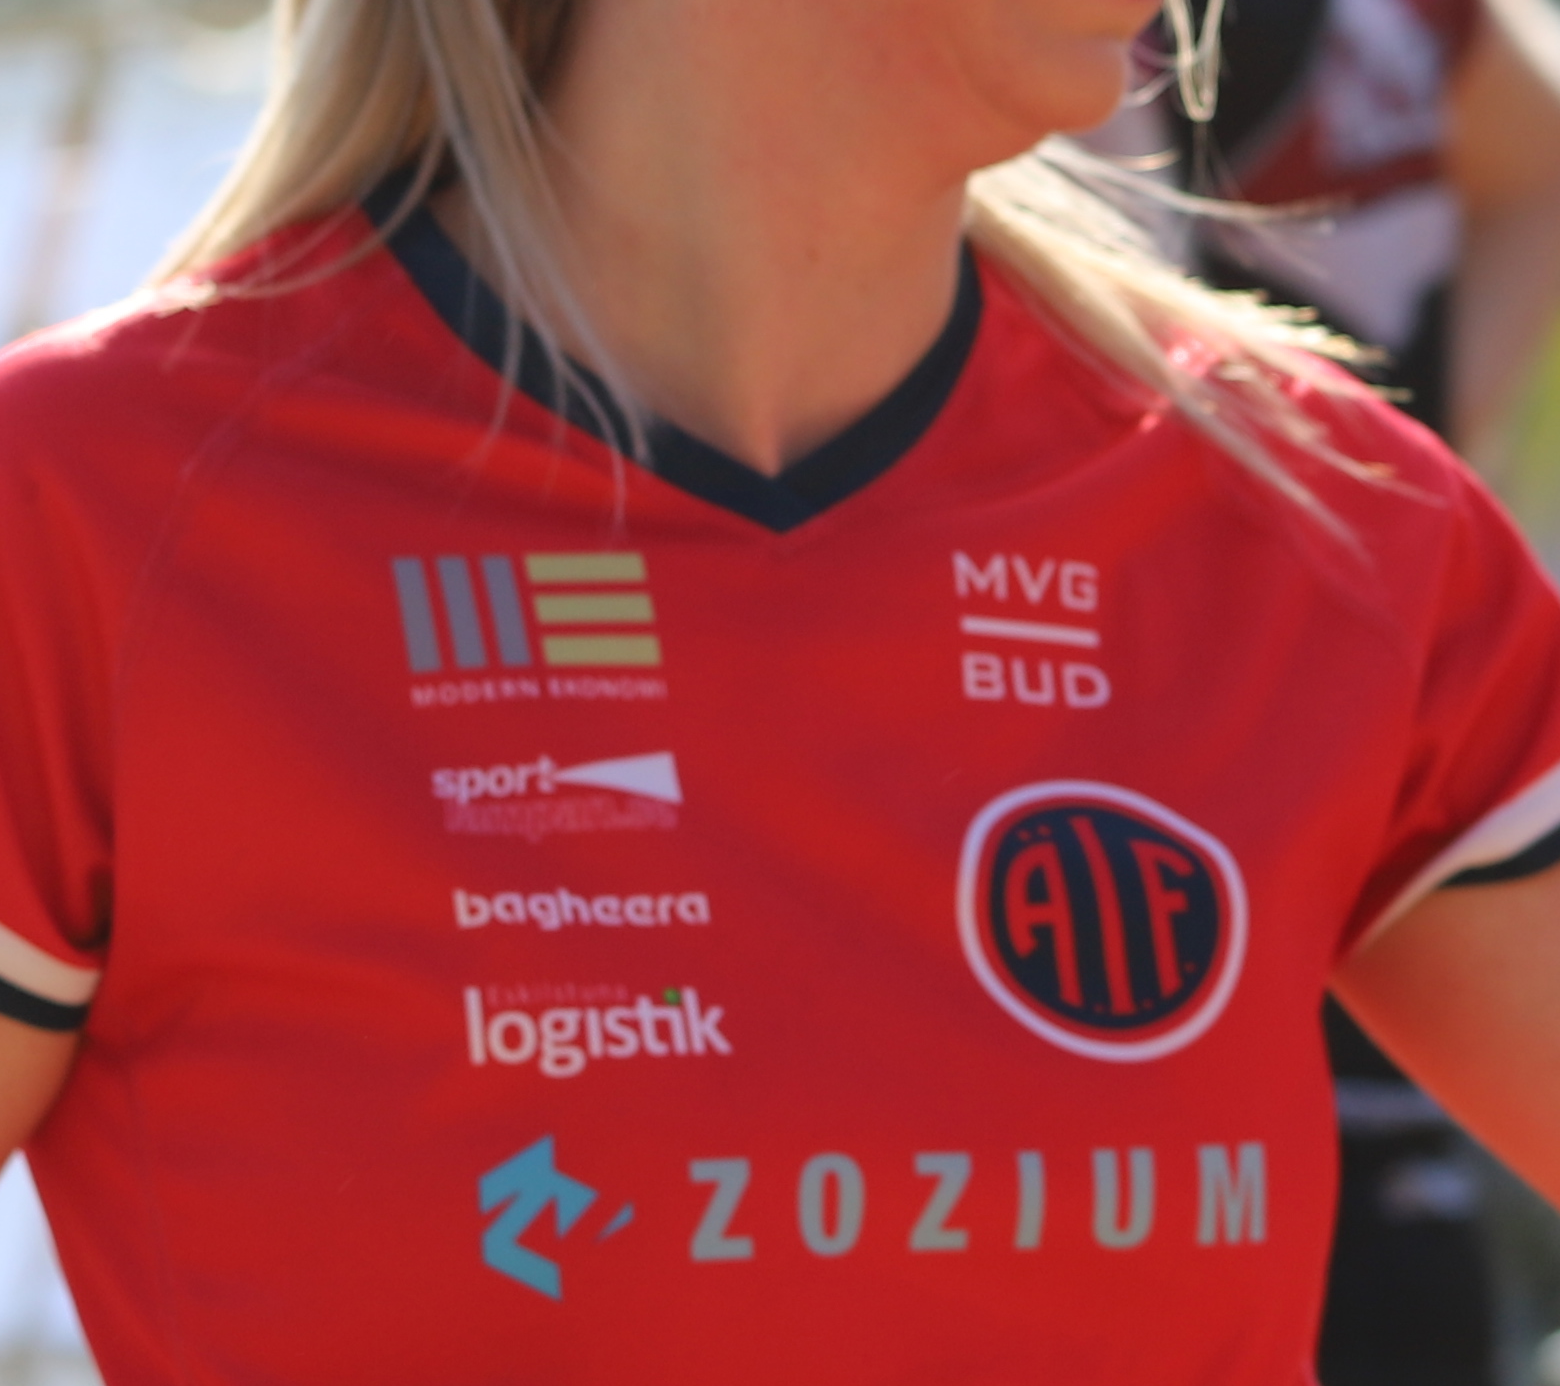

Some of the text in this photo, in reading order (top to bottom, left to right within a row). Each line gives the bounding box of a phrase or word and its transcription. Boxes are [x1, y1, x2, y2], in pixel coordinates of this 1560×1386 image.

[953, 549, 1099, 612] MVG
[961, 651, 1111, 709] BUD
[431, 755, 557, 805] sport
[452, 887, 711, 931] bagheera
[464, 985, 732, 1078] logistik
[687, 1142, 1268, 1260] ZOZIUM
